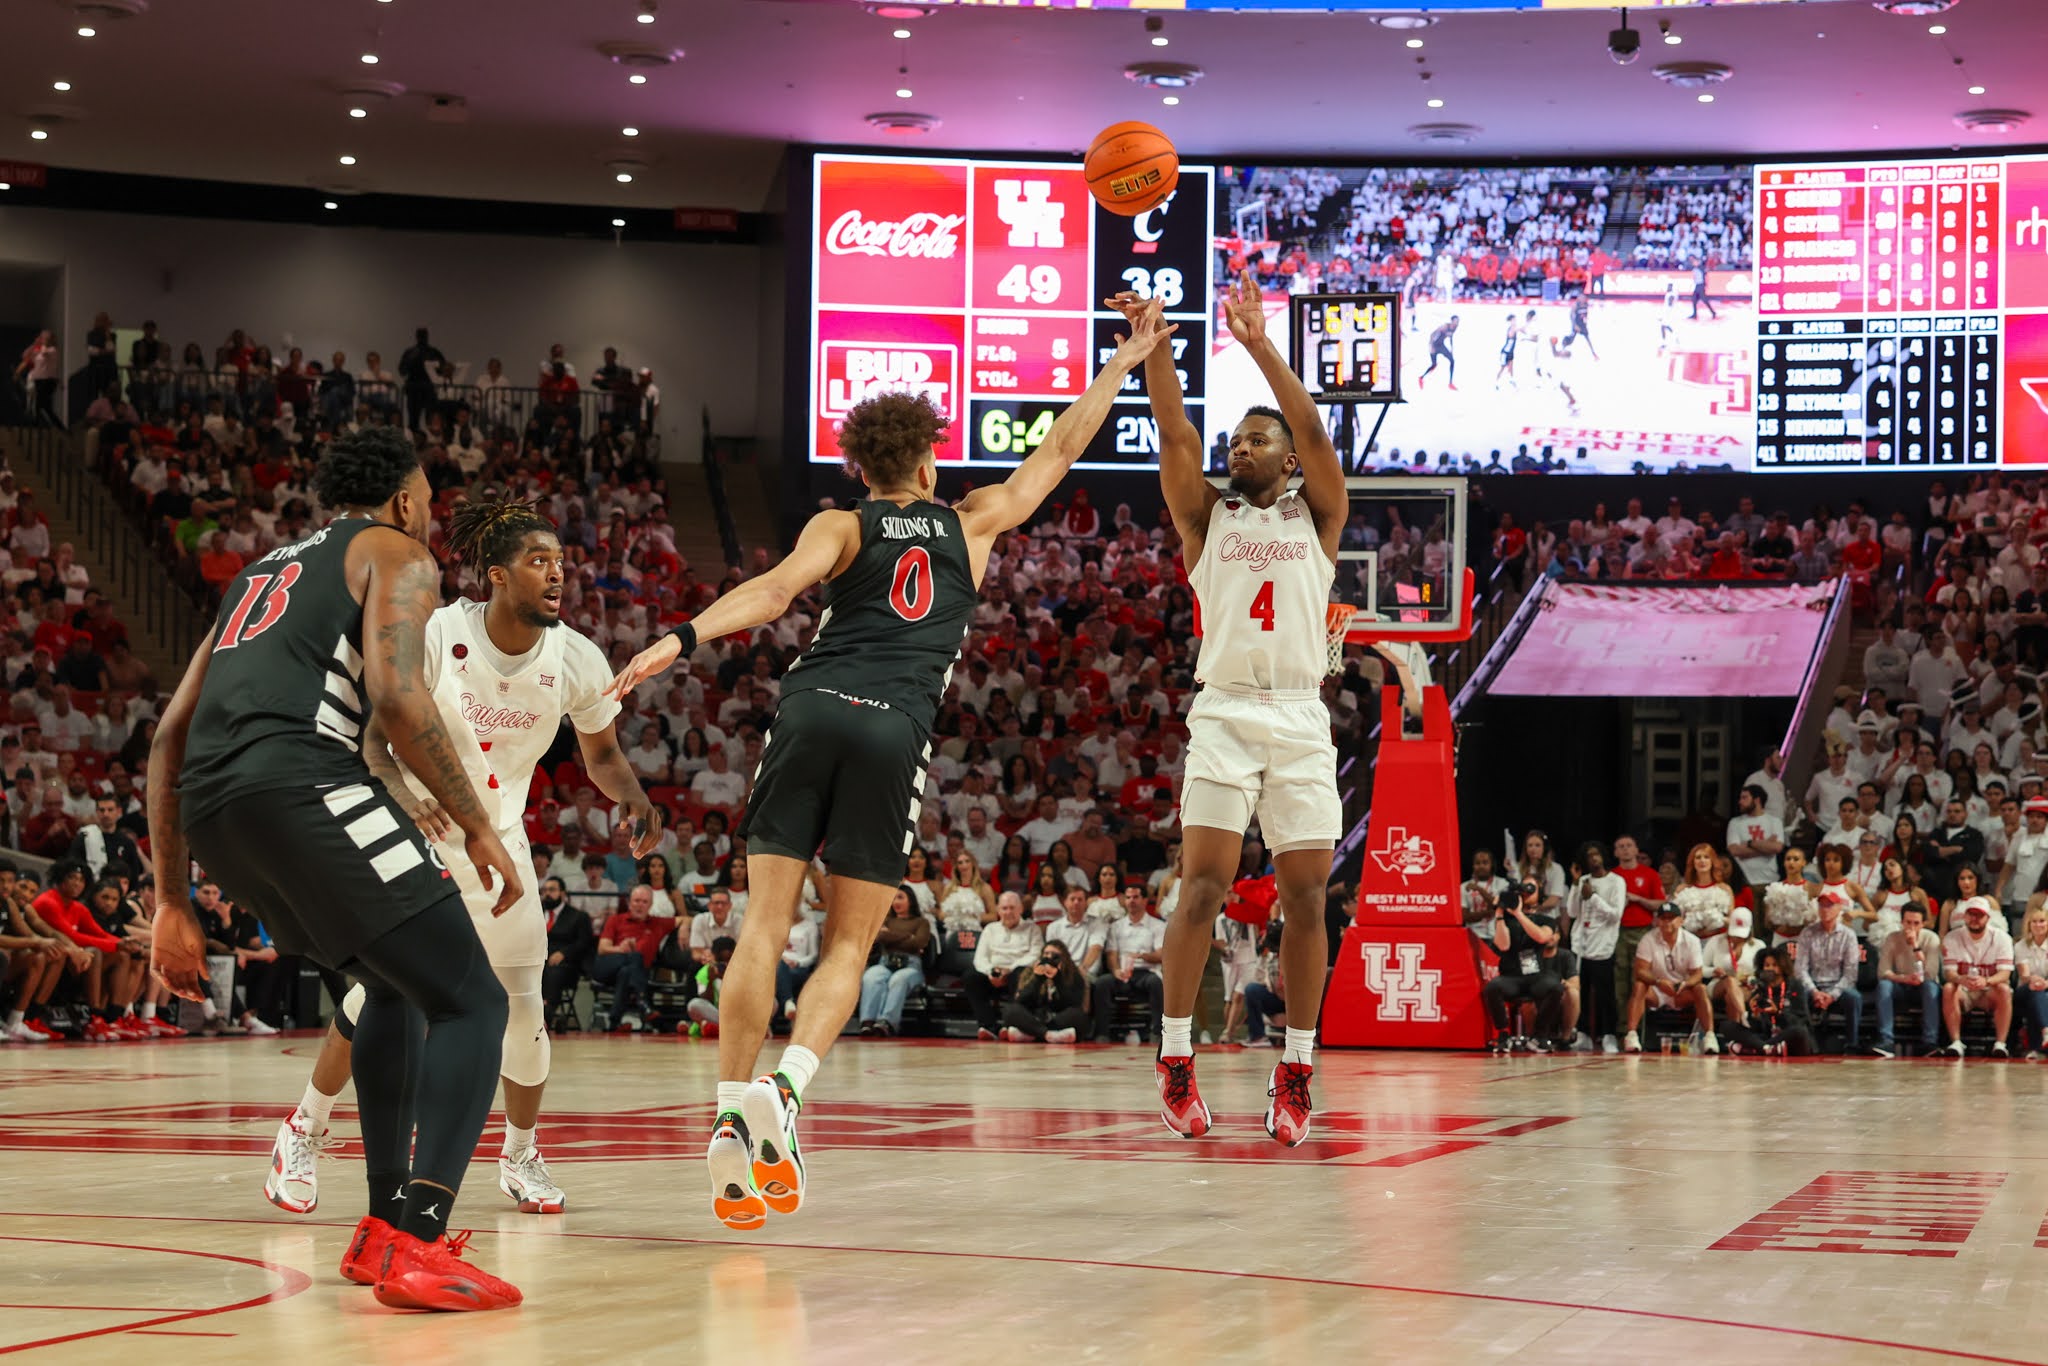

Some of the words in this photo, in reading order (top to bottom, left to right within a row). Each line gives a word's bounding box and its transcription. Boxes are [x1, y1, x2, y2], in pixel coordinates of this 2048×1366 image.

[1871, 168, 1898, 181] PTS
[1973, 165, 1997, 178] FLS
[1767, 192, 1776, 208] 1
[1881, 189, 1895, 206] 4
[1912, 188, 1924, 205] 2
[1942, 186, 1962, 204] 10
[1976, 185, 1987, 202] 1
[1766, 216, 1778, 233] 4
[1911, 213, 1924, 230] 2
[1943, 211, 1955, 228] 2
[1976, 210, 1987, 227] 1
[1976, 237, 1988, 253] 2
[1910, 263, 1923, 280] 2
[1975, 262, 1988, 278] 2
[997, 264, 1061, 304] 49
[1121, 267, 1183, 307] 38
[1909, 288, 1923, 305] 4
[1976, 286, 1986, 304] 1
[1325, 304, 1388, 334] 6:43
[1792, 321, 1845, 334] PLAYER
[1868, 320, 1896, 333] PTS
[1936, 318, 1963, 331] AST
[1970, 317, 1996, 330] FLS
[1051, 338, 1069, 360] 5
[1171, 339, 1188, 360] 7
[1909, 339, 1923, 357] 4
[1944, 339, 1955, 357] 1
[1977, 336, 1988, 354] 1
[846, 351, 932, 382] BUD
[1052, 367, 1070, 388] 2
[1763, 368, 1775, 386] 2
[1785, 368, 1842, 386] JAMES
[1876, 365, 1892, 383] 7
[1941, 366, 1952, 383] 1
[1976, 363, 1989, 380] 2
[1759, 393, 1779, 411] 13
[1876, 390, 1890, 408] 4
[1907, 391, 1920, 409] 7
[1975, 389, 1987, 407] 1
[981, 410, 1054, 453] 6:4
[1116, 416, 1160, 453] 2N
[1521, 426, 1743, 446] FERTITTA
[1758, 419, 1779, 436] 15
[1907, 417, 1921, 435] 4
[1976, 415, 1987, 433] 1
[1533, 437, 1720, 457] CENTER
[1757, 446, 1778, 462] 41
[1785, 444, 1863, 462] LUKOSIUS
[1878, 443, 1891, 460] 9
[1909, 444, 1921, 461] 2
[1942, 443, 1952, 460] 1
[1975, 441, 1987, 459] 2
[881, 516, 931, 540] SKILLINGS
[933, 518, 949, 538] JR.
[1219, 532, 1308, 572] Cougars
[889, 545, 934, 622] 0
[213, 561, 303, 655] 13
[1249, 580, 1275, 632] 4
[461, 693, 541, 736] Cougars
[1365, 893, 1395, 905] BEST
[1395, 894, 1409, 905] IN
[1409, 894, 1449, 905] TEXAS
[1360, 942, 1443, 1022] UH
